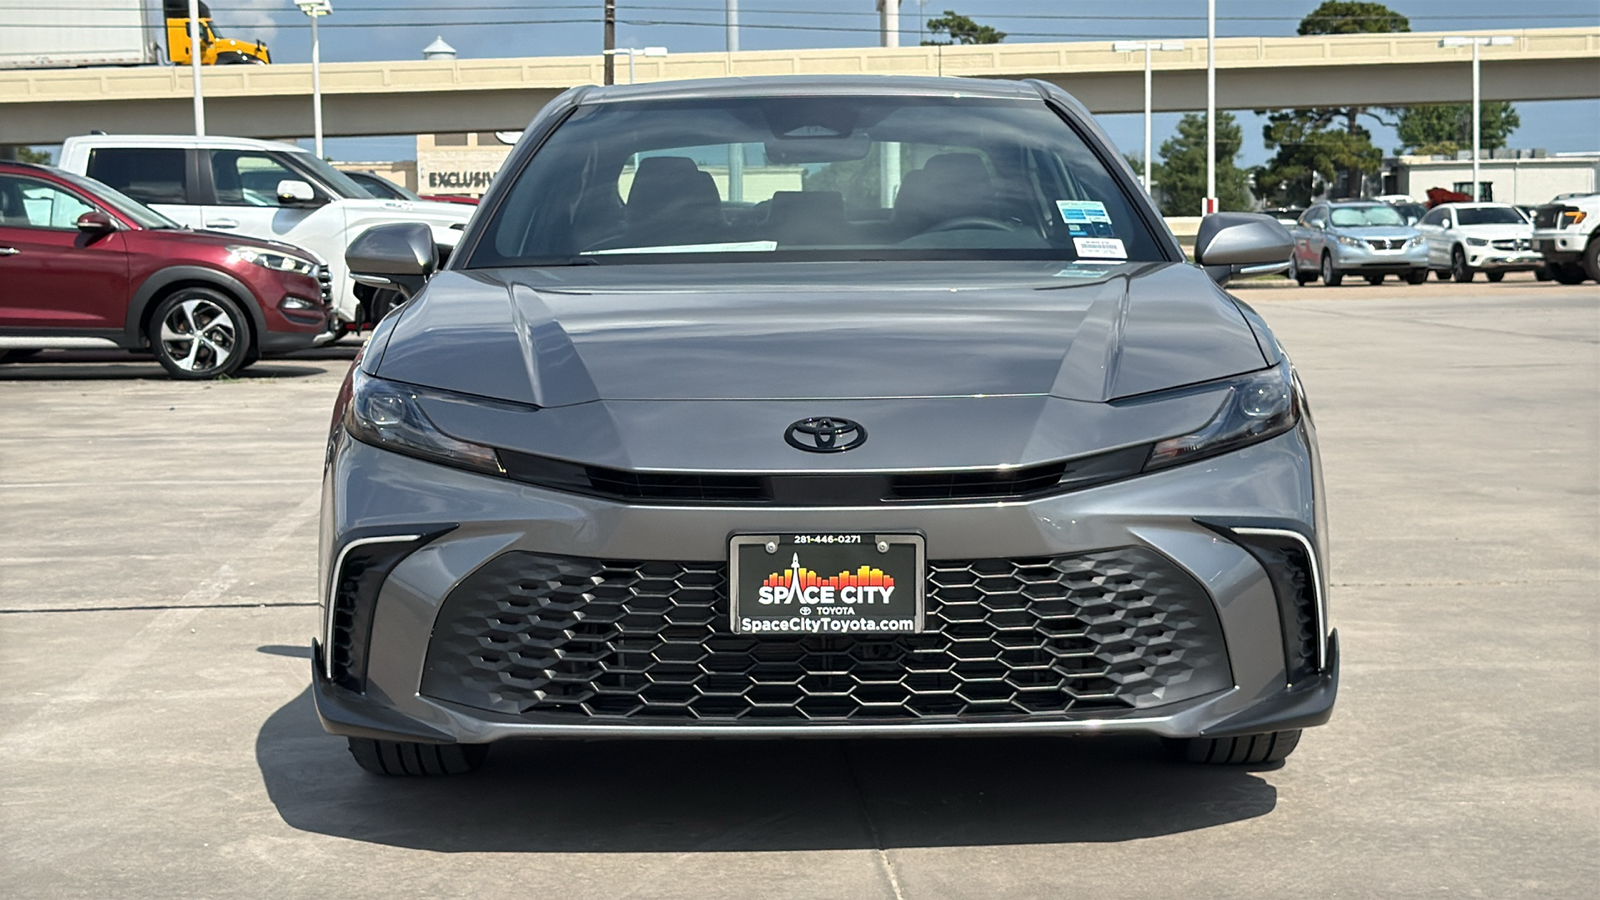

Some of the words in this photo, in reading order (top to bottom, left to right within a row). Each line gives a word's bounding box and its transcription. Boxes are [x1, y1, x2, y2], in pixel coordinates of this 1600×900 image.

[794, 535, 861, 544] 281-446-0271
[758, 586, 835, 605] SPACE
[840, 586, 895, 604] CITY
[817, 607, 855, 615] TOYOTA
[742, 617, 914, 633] SpaceCityToyota.com
